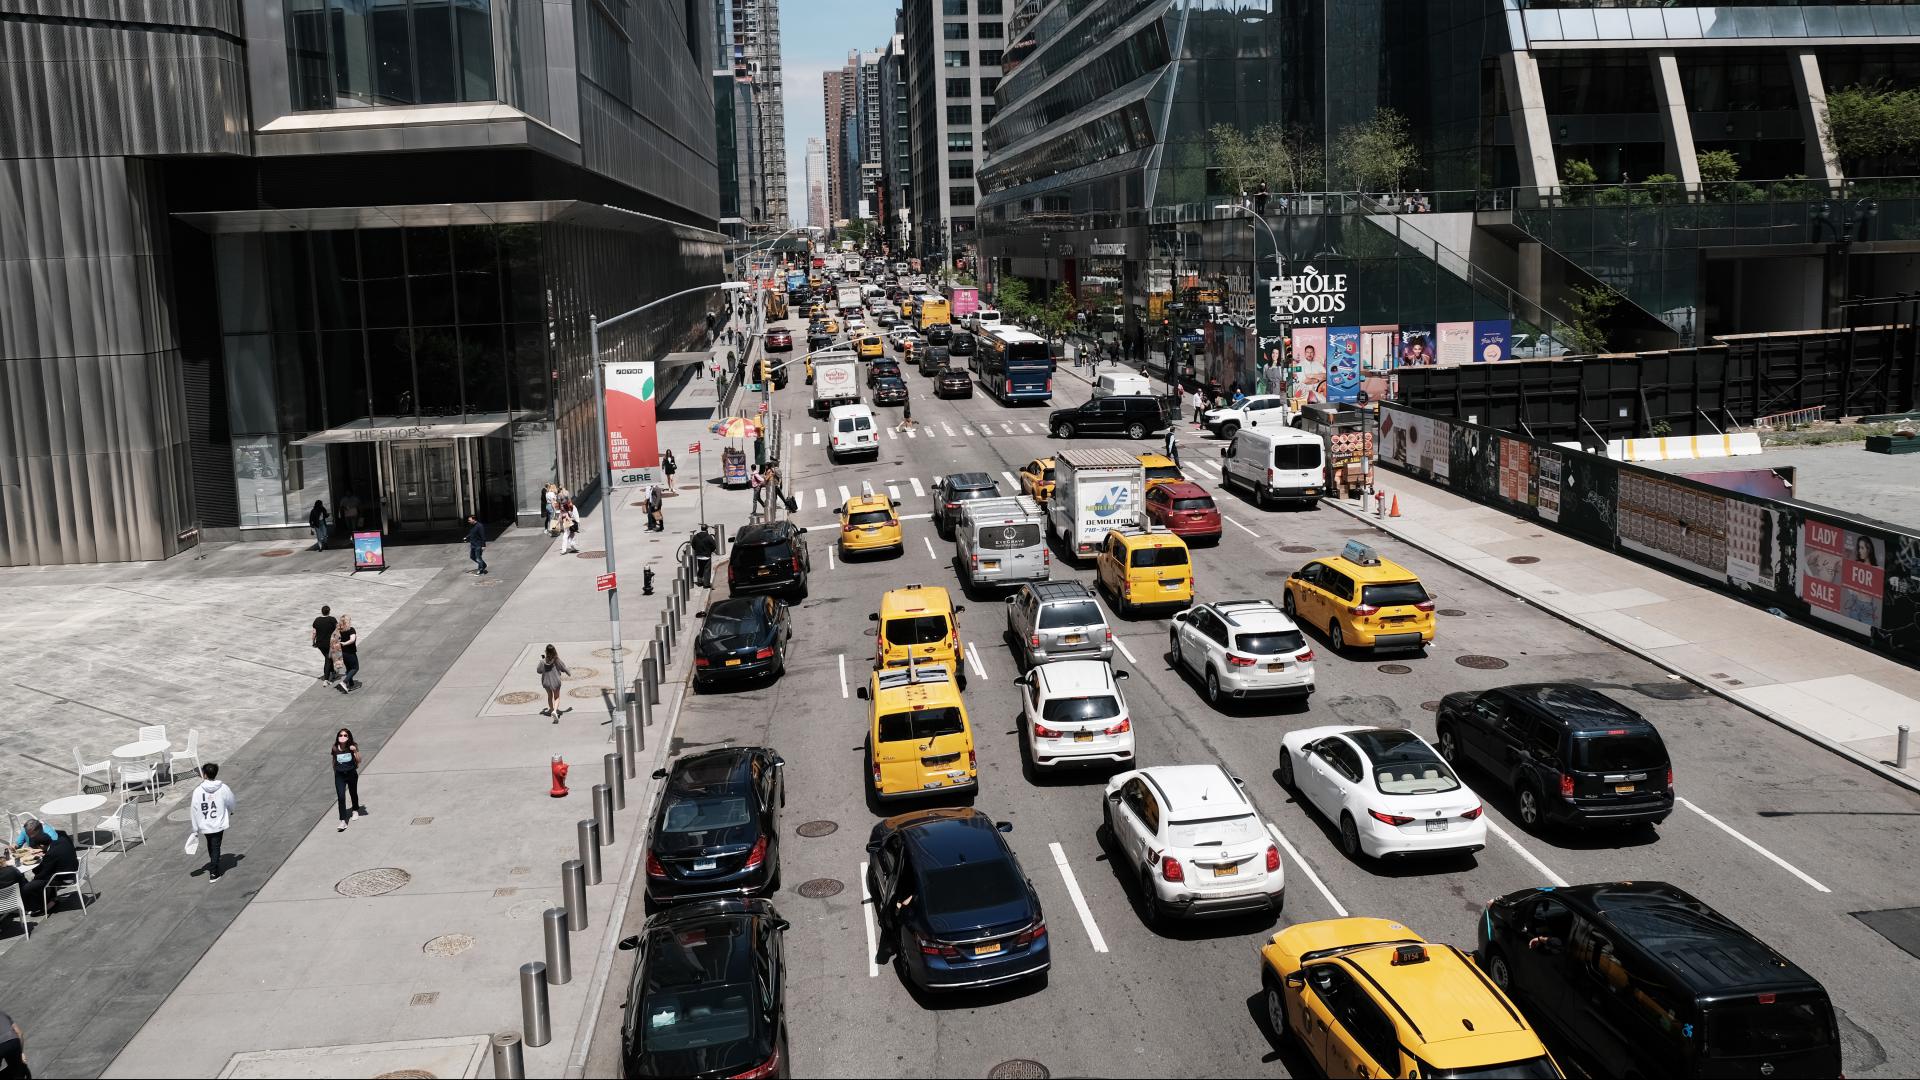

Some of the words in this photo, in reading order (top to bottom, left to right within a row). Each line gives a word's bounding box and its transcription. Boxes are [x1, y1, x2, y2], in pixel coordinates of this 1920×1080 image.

[1270, 270, 1347, 294] HOLE
[1288, 316, 1335, 325] ARKET
[611, 438, 629, 446] ESTATE
[611, 445, 631, 453] CAPITAL
[621, 474, 651, 483] CBRE
[1085, 518, 1134, 526] DEMOLITION
[1811, 525, 1838, 547] LADY
[1851, 566, 1873, 587] FOR
[1810, 582, 1835, 603] SALE
